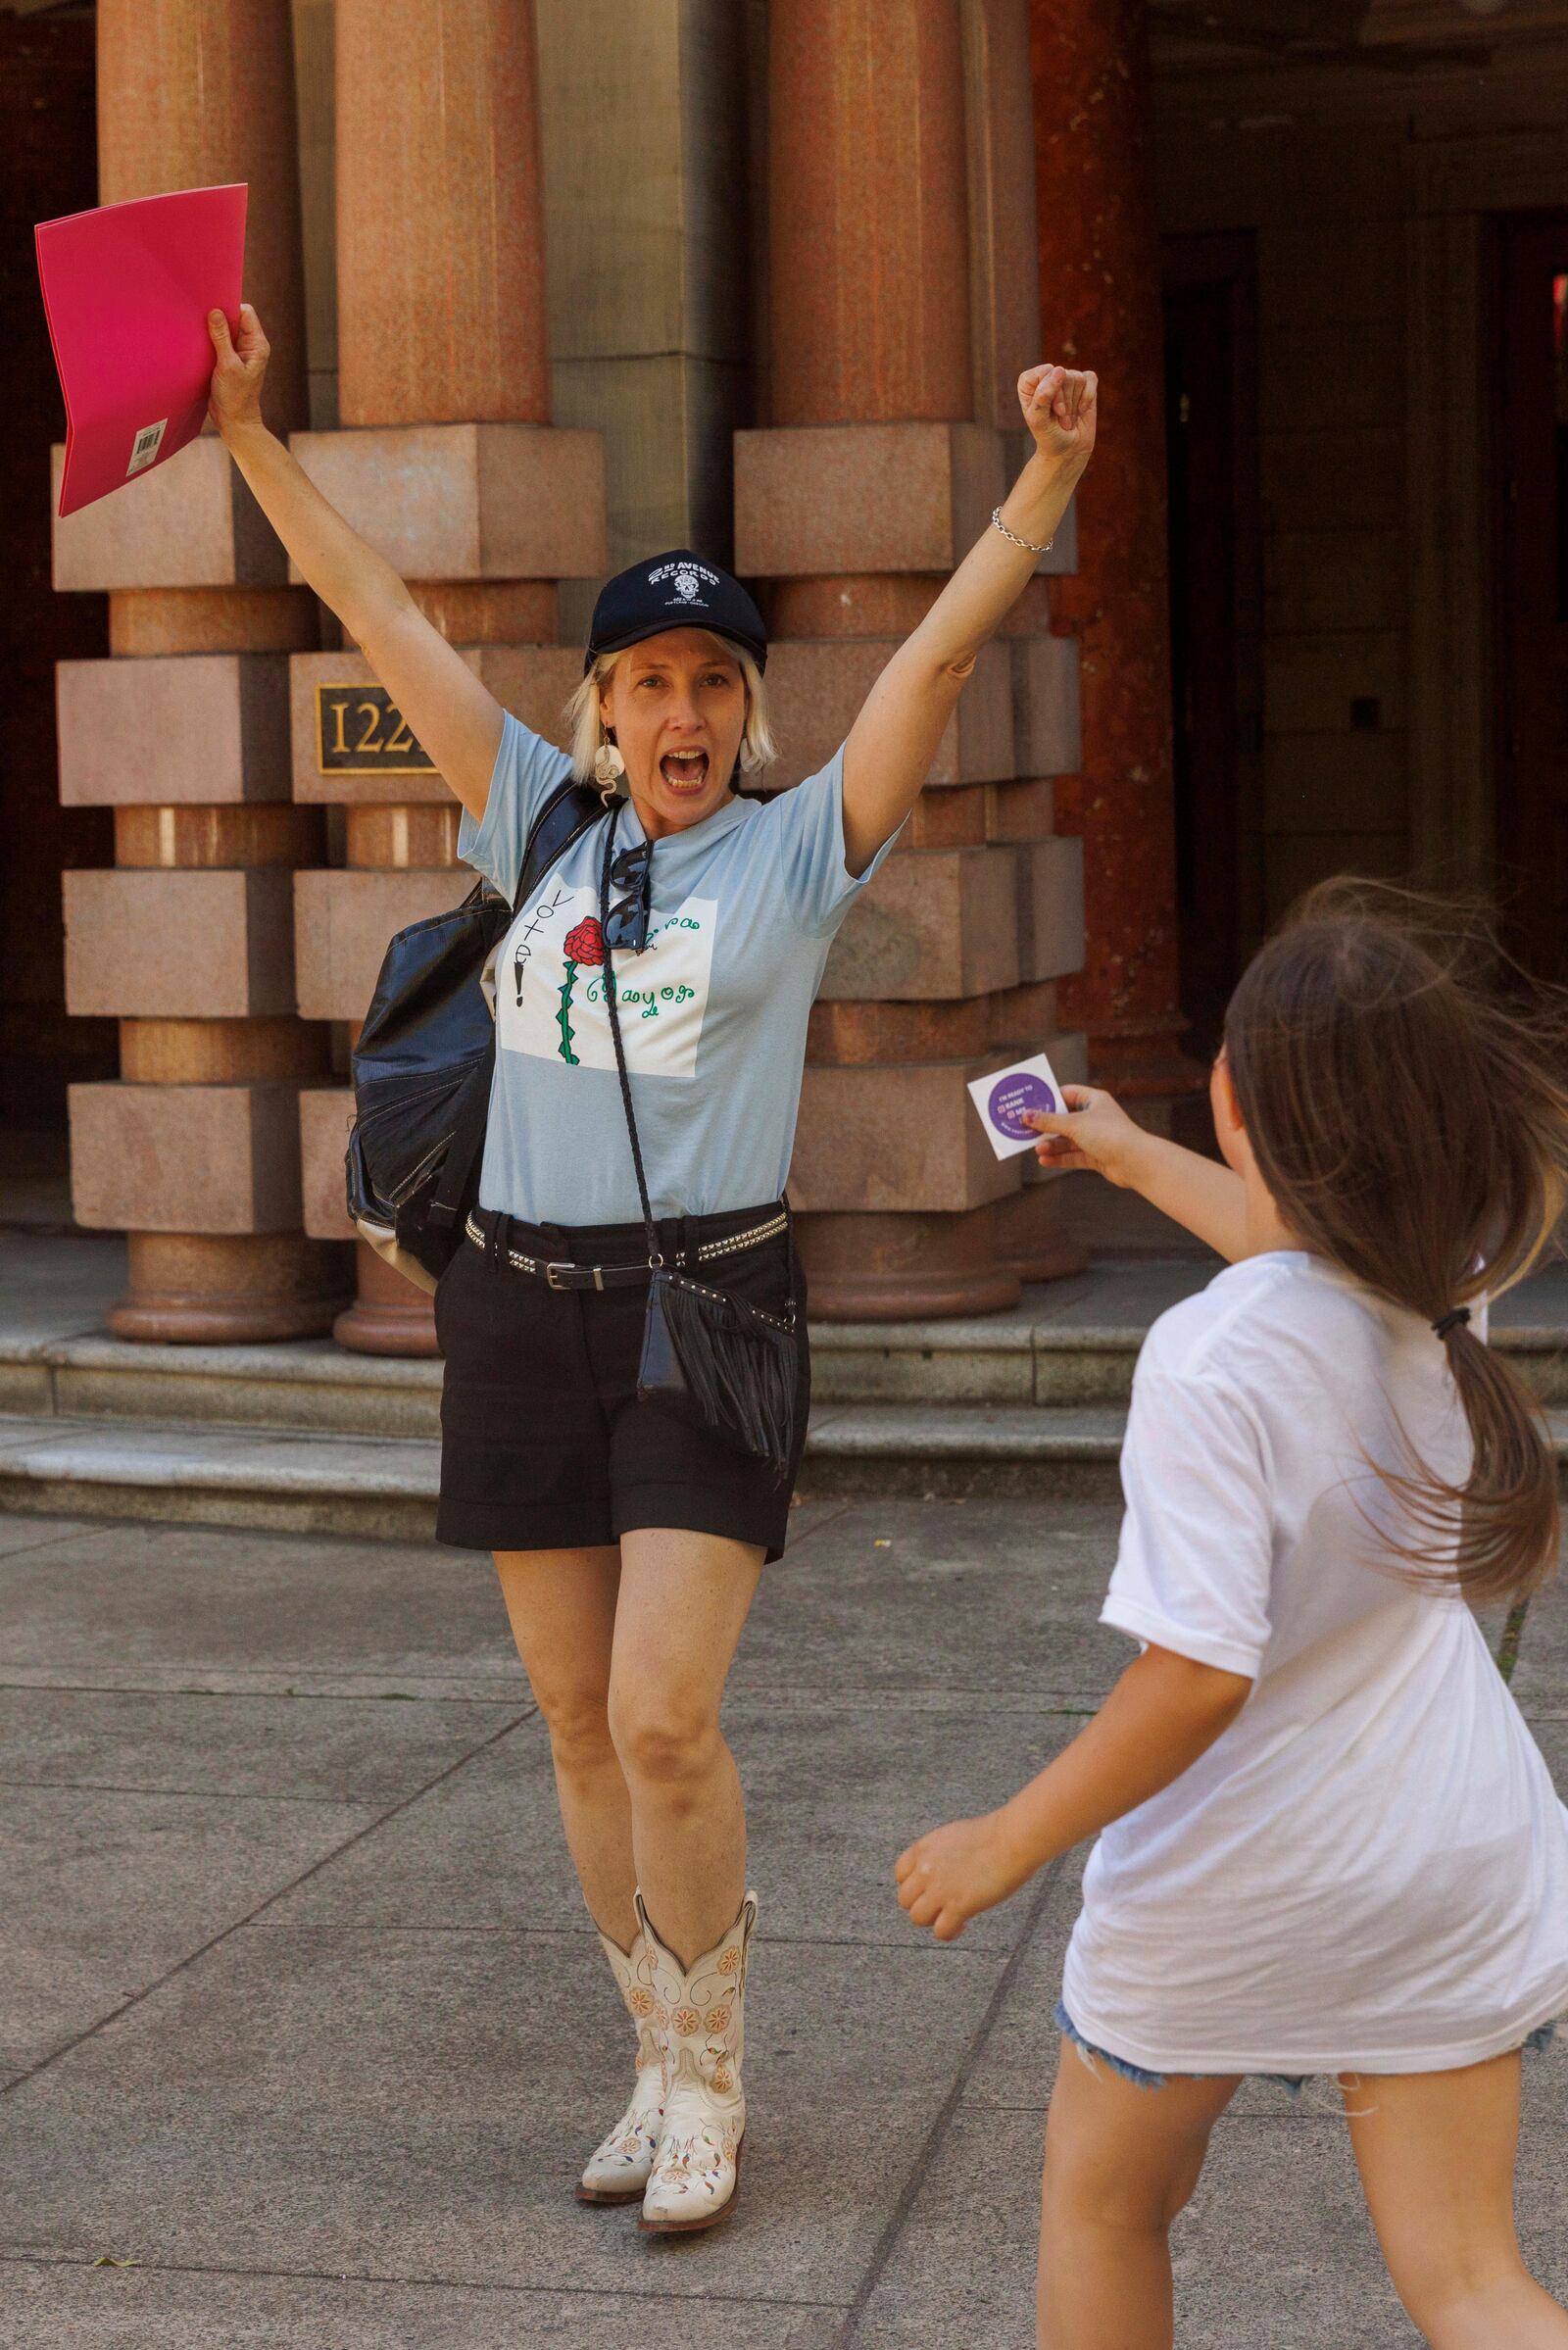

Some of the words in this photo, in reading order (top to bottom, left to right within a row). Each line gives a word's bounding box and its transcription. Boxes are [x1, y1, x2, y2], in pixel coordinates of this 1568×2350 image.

[648, 563, 676, 582] 2ND
[677, 562, 720, 584] AVENUE
[651, 569, 716, 585] RECORDS
[328, 702, 426, 754] 122
[1025, 1084, 1034, 1093] TO
